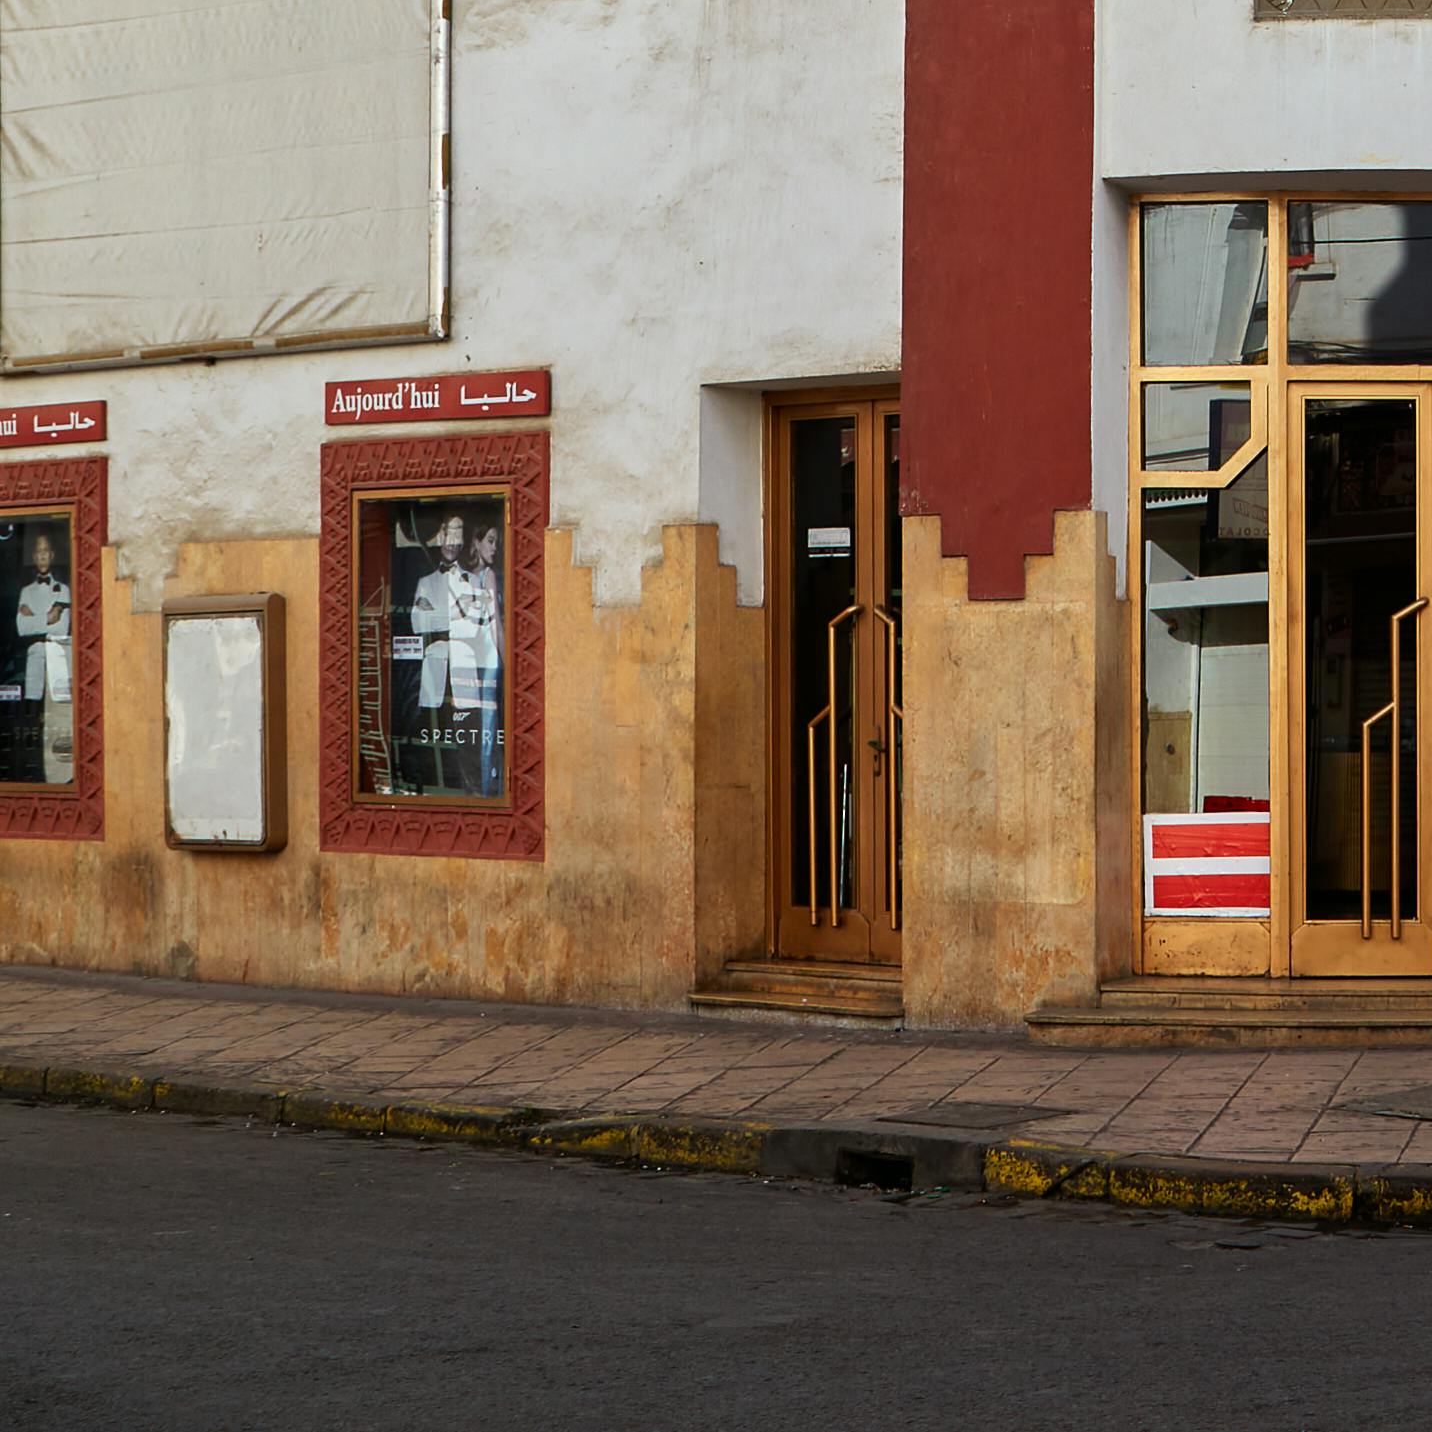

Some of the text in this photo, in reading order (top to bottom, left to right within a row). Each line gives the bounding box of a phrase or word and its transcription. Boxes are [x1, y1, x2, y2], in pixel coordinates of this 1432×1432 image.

[331, 383, 440, 420] Aujourd'hui
[460, 382, 537, 411] حاليا
[33, 411, 96, 438] حاليا
[420, 729, 505, 744] SPECTRE
